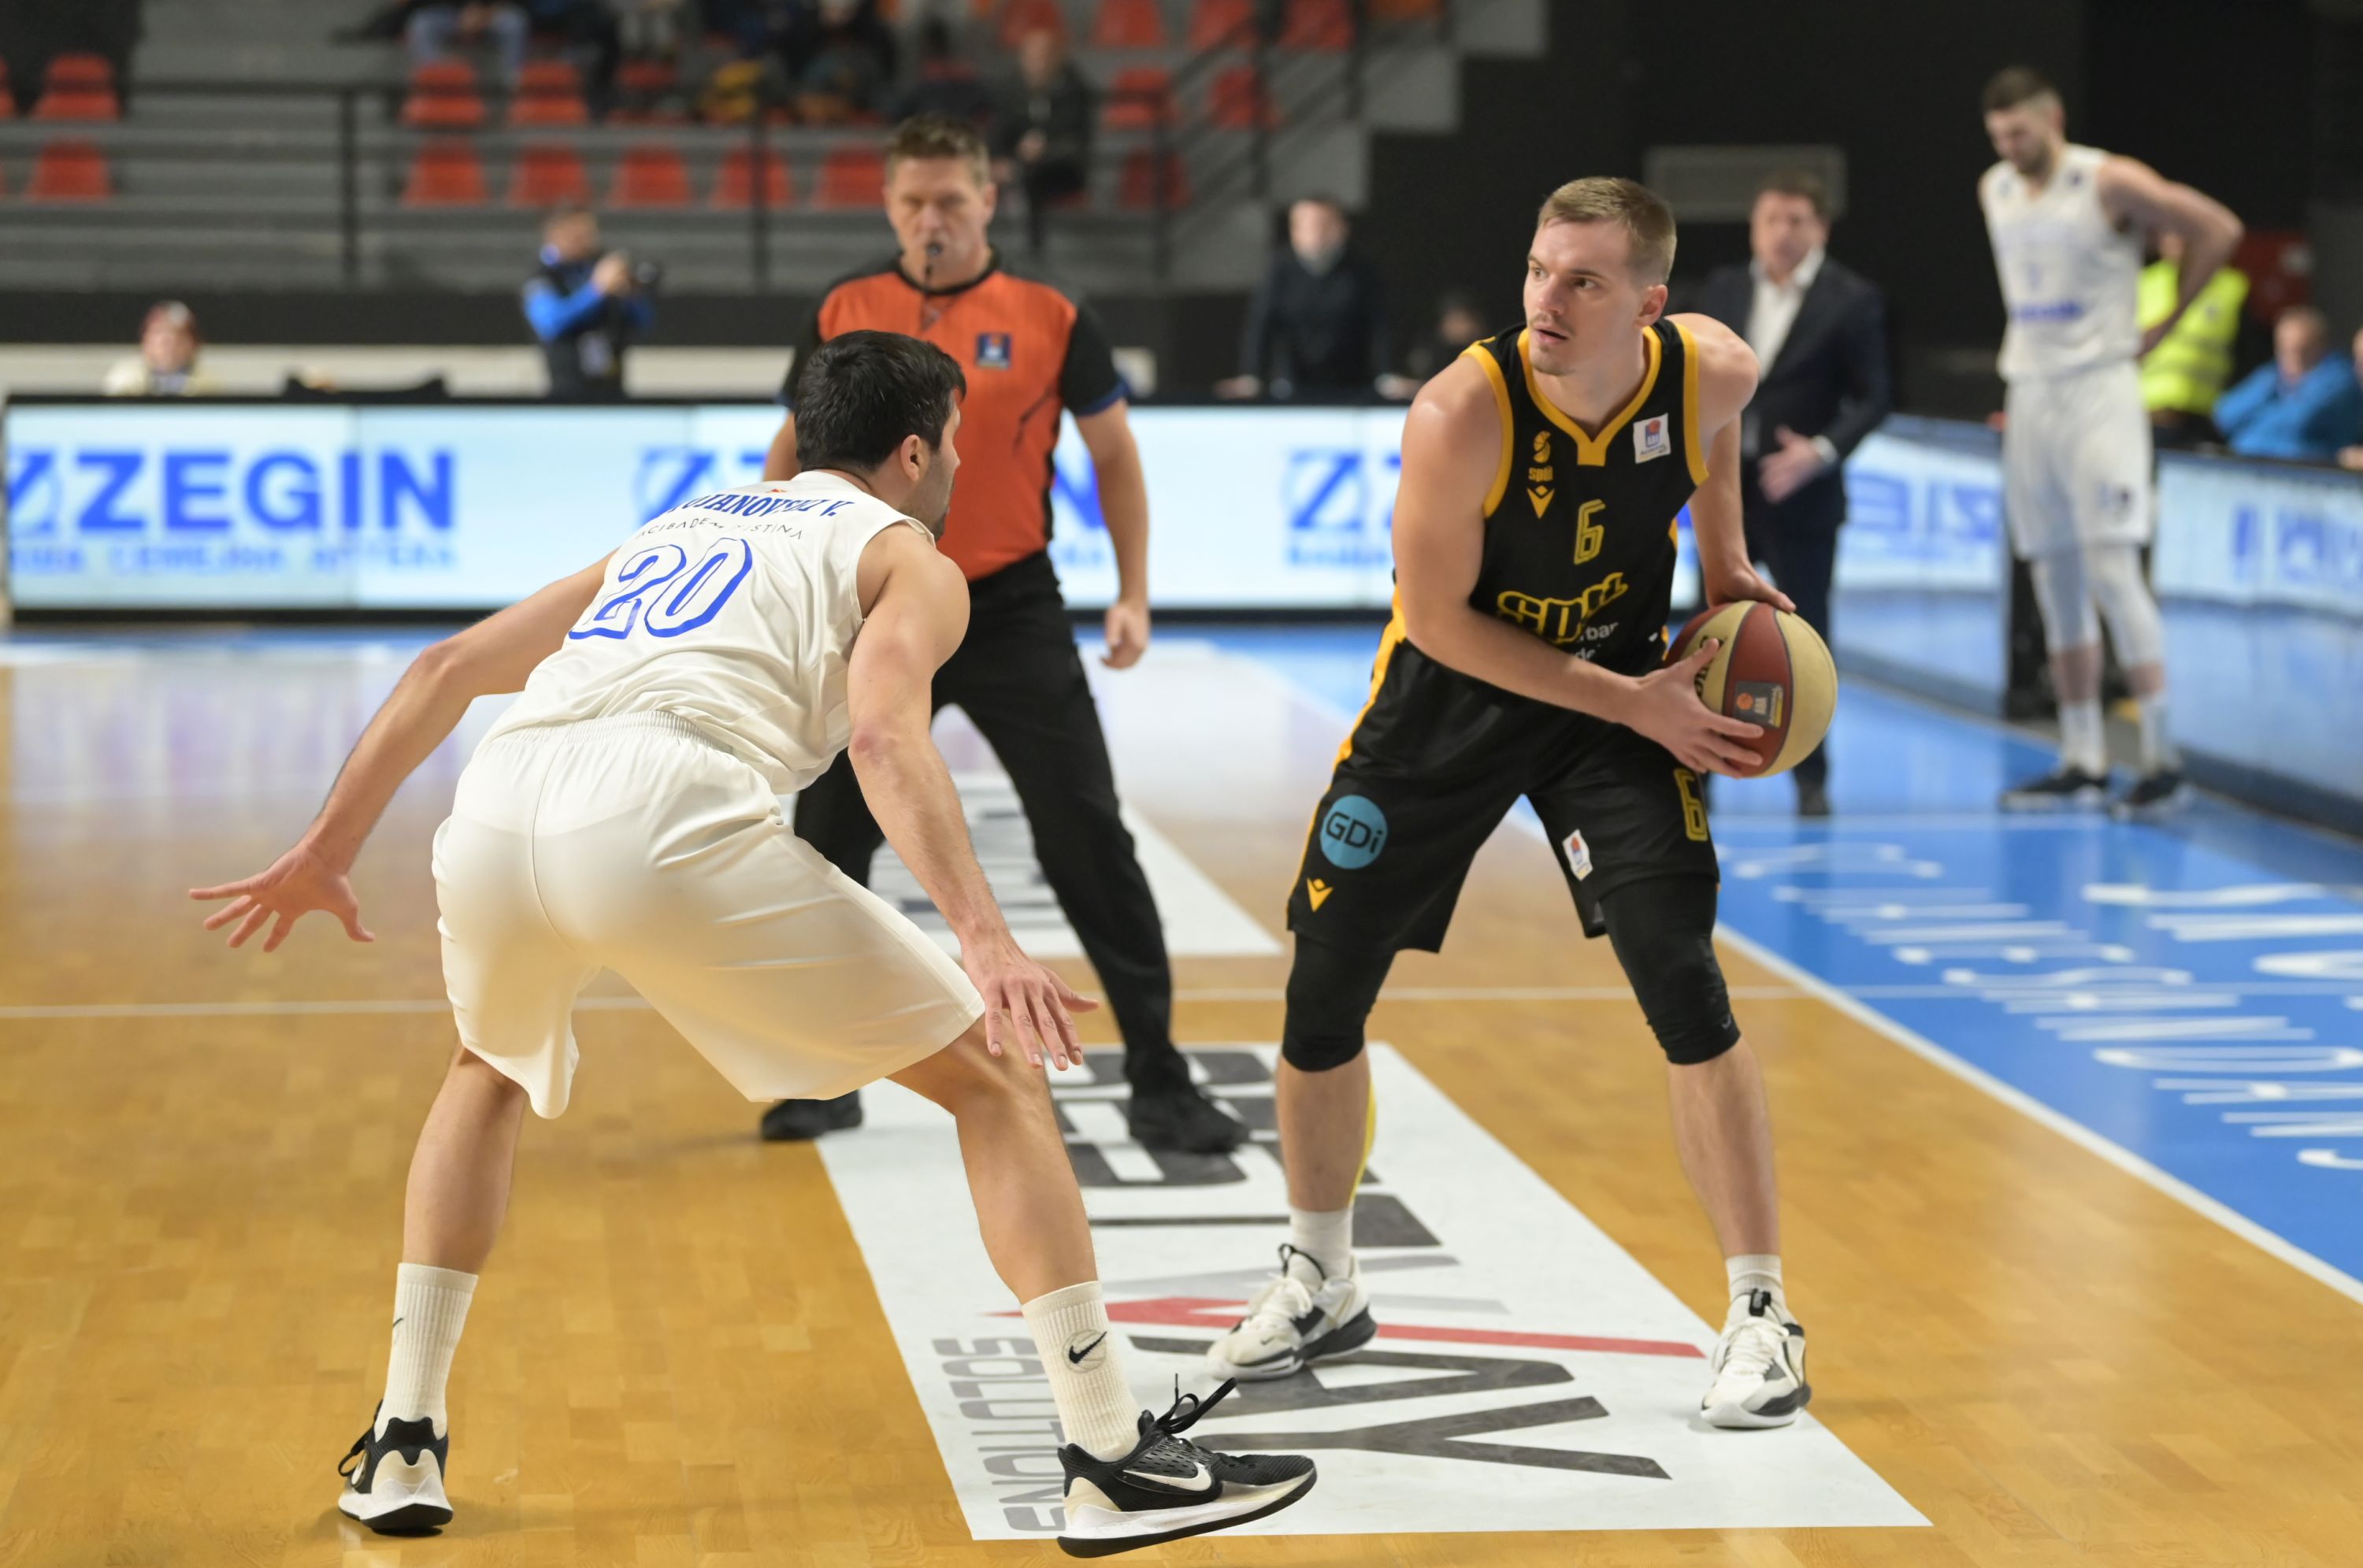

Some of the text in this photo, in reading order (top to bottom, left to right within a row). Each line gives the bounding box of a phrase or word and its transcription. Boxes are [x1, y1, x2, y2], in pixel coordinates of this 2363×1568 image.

[76, 451, 453, 531] ZEGIN
[668, 494, 829, 517] OJANOVSKI
[1574, 499, 1606, 565] 6
[568, 537, 753, 639] 20
[1326, 810, 1383, 854] GDi
[1674, 768, 1708, 841] 6
[931, 1337, 1066, 1532] SOLUTIONS
